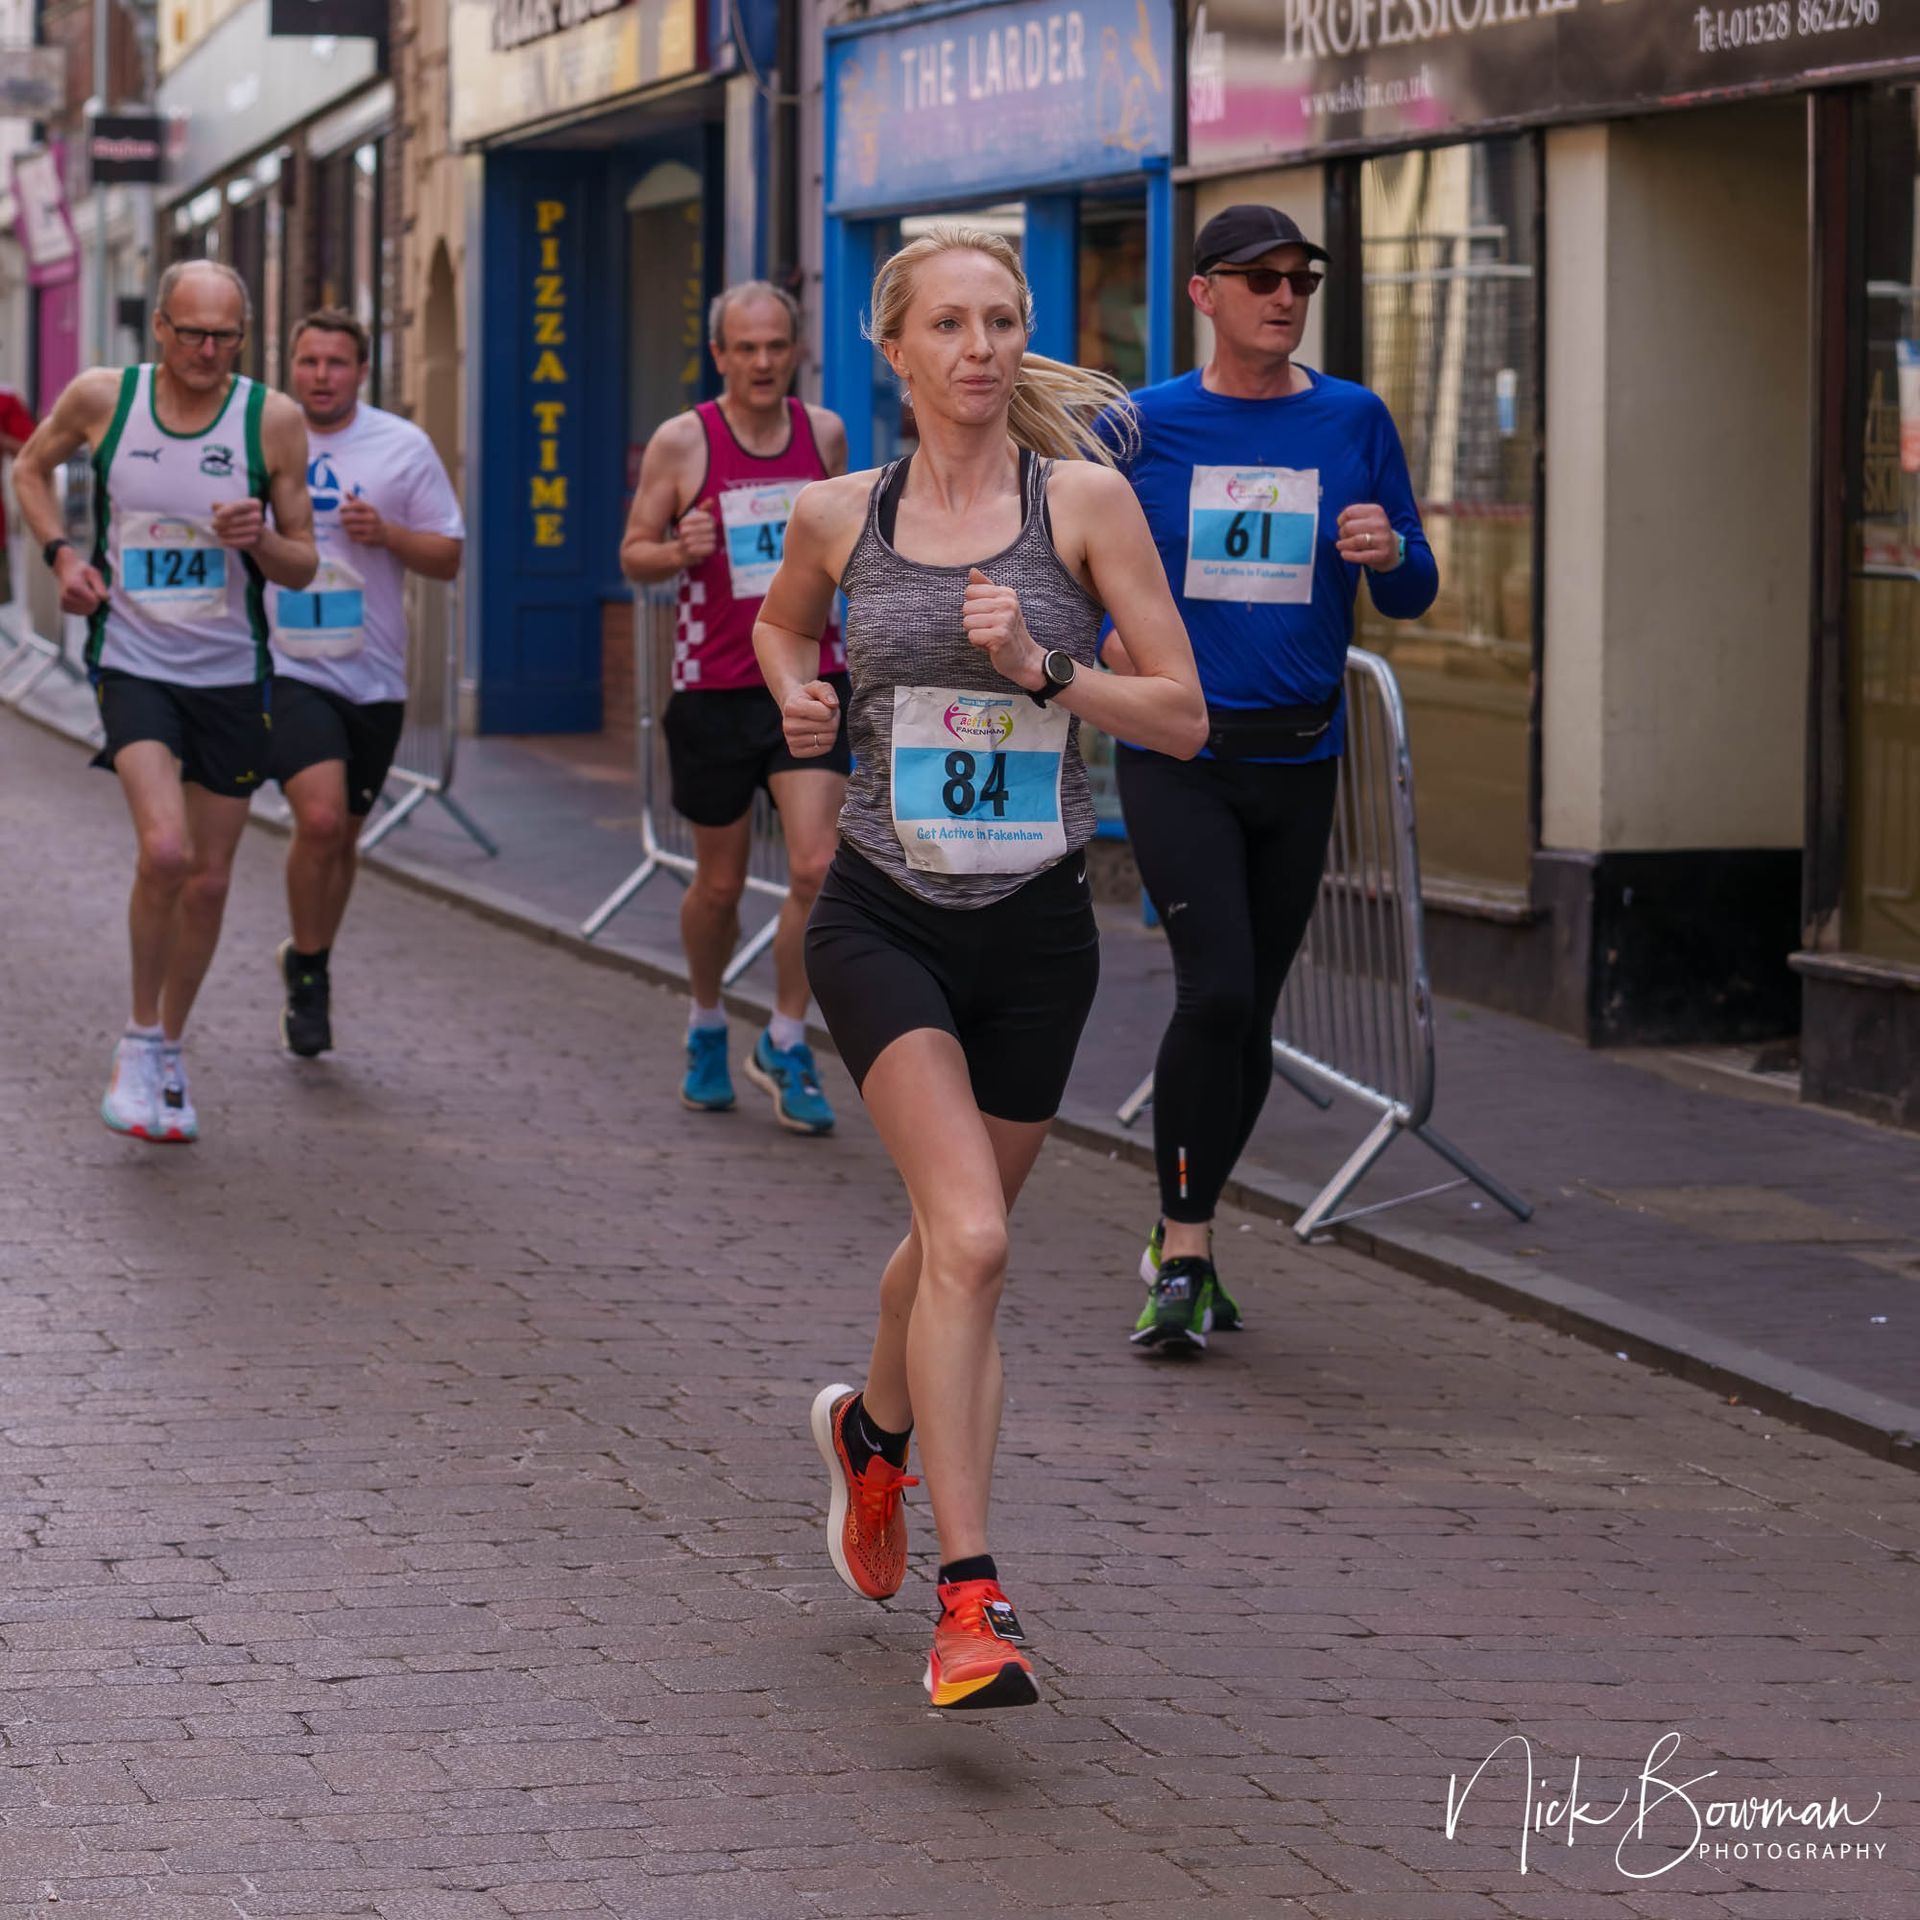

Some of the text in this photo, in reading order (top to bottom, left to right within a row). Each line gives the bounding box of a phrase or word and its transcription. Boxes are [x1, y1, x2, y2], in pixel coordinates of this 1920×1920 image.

[1284, 0, 1580, 61] PROFESS
[902, 10, 1086, 112] THE LARDER
[530, 200, 568, 545] PIZZA TIME
[756, 520, 787, 561] 4
[1225, 510, 1271, 559] 61
[145, 550, 207, 587] 124
[956, 726, 1005, 736] FAKENHAM
[942, 750, 1009, 817] 84
[917, 827, 1043, 841] Get Active in Fakenham
